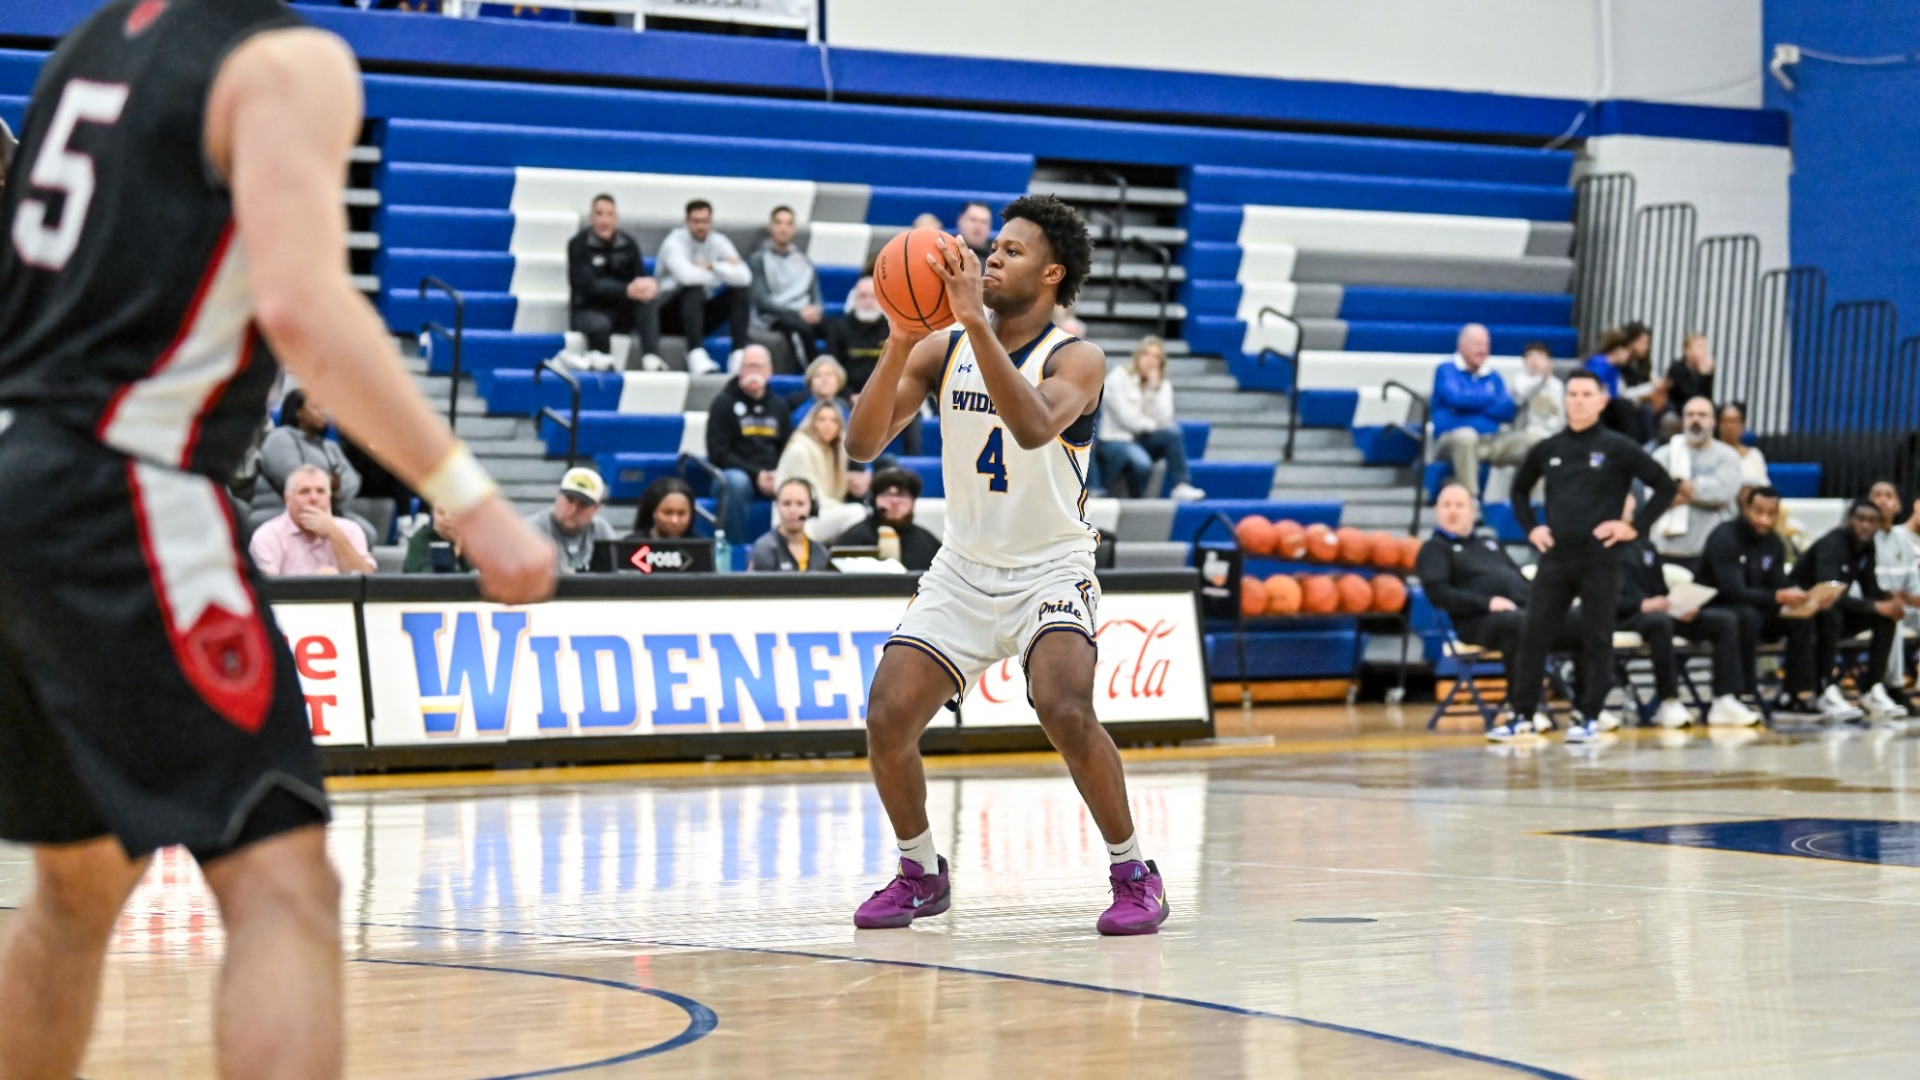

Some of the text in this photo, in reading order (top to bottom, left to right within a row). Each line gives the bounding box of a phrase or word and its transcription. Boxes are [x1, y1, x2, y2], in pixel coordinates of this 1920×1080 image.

[11, 77, 131, 271] 5
[976, 426, 1009, 493] 4
[646, 551, 682, 567] POSS
[1038, 599, 1083, 622] Pride
